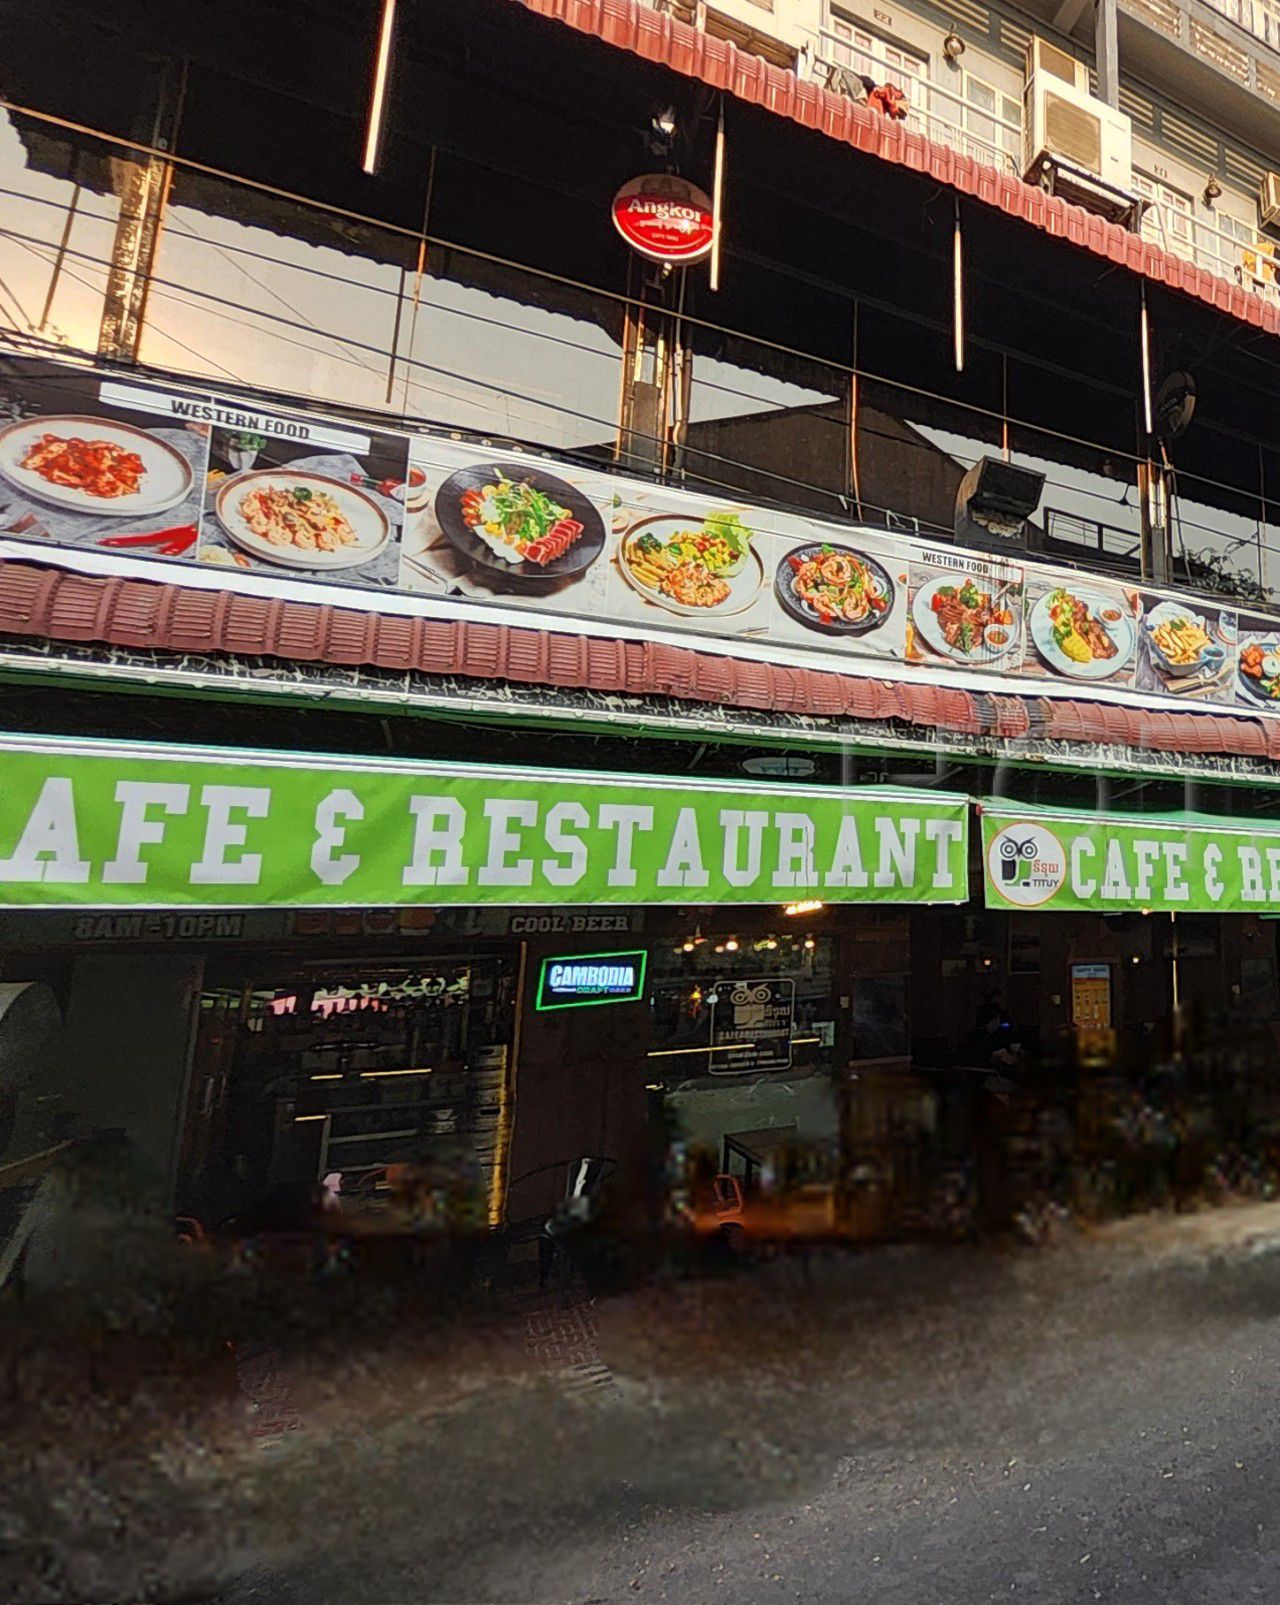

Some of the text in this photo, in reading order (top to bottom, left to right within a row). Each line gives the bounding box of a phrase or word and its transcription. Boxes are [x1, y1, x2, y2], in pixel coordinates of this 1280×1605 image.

[627, 199, 702, 222] Angkor
[171, 399, 311, 440] WESTERN FOOD
[922, 552, 989, 574] WESTERN FOOD
[310, 789, 365, 885] &
[402, 795, 963, 888] RESTAURANT
[1071, 836, 1189, 900] CAFE
[1203, 843, 1224, 900] &
[1032, 879, 1059, 888] TITUY
[511, 915, 629, 933] COOL BEER
[550, 965, 634, 987] CAMBODIA
